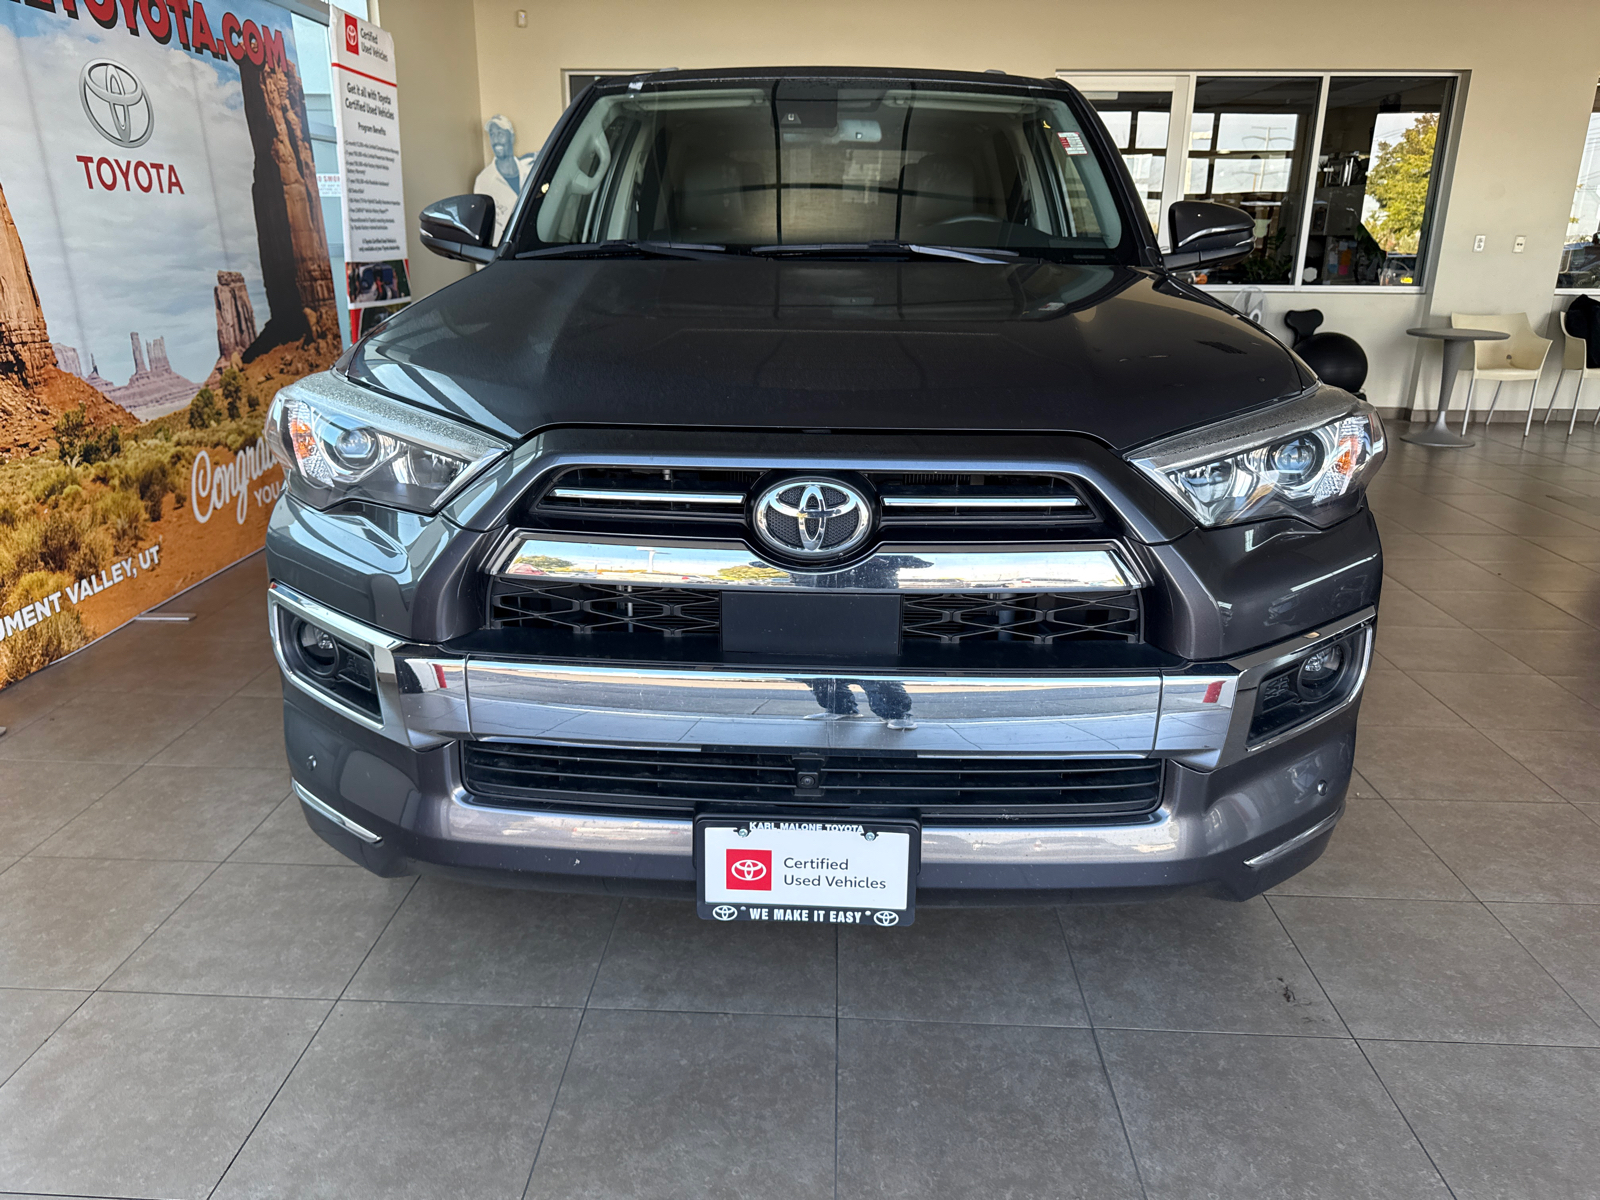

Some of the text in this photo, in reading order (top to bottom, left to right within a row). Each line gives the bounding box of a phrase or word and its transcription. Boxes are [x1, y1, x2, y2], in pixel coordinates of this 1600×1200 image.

[360, 27, 378, 45] Certified
[361, 41, 389, 62] Used Vehicles
[346, 82, 356, 95] Get
[367, 89, 377, 101] with
[377, 91, 392, 106] Toyota
[345, 97, 395, 121] Certified Used Vehicles
[76, 154, 185, 195] TOYOTA
[65, 557, 137, 605] VALLEY,
[138, 545, 160, 570] UT
[749, 821, 865, 833] KARL MALONE TOYOTA
[783, 857, 849, 871] Certified
[783, 874, 887, 890] Used Vehicles
[749, 908, 862, 924] WE MAKE IT EASY
